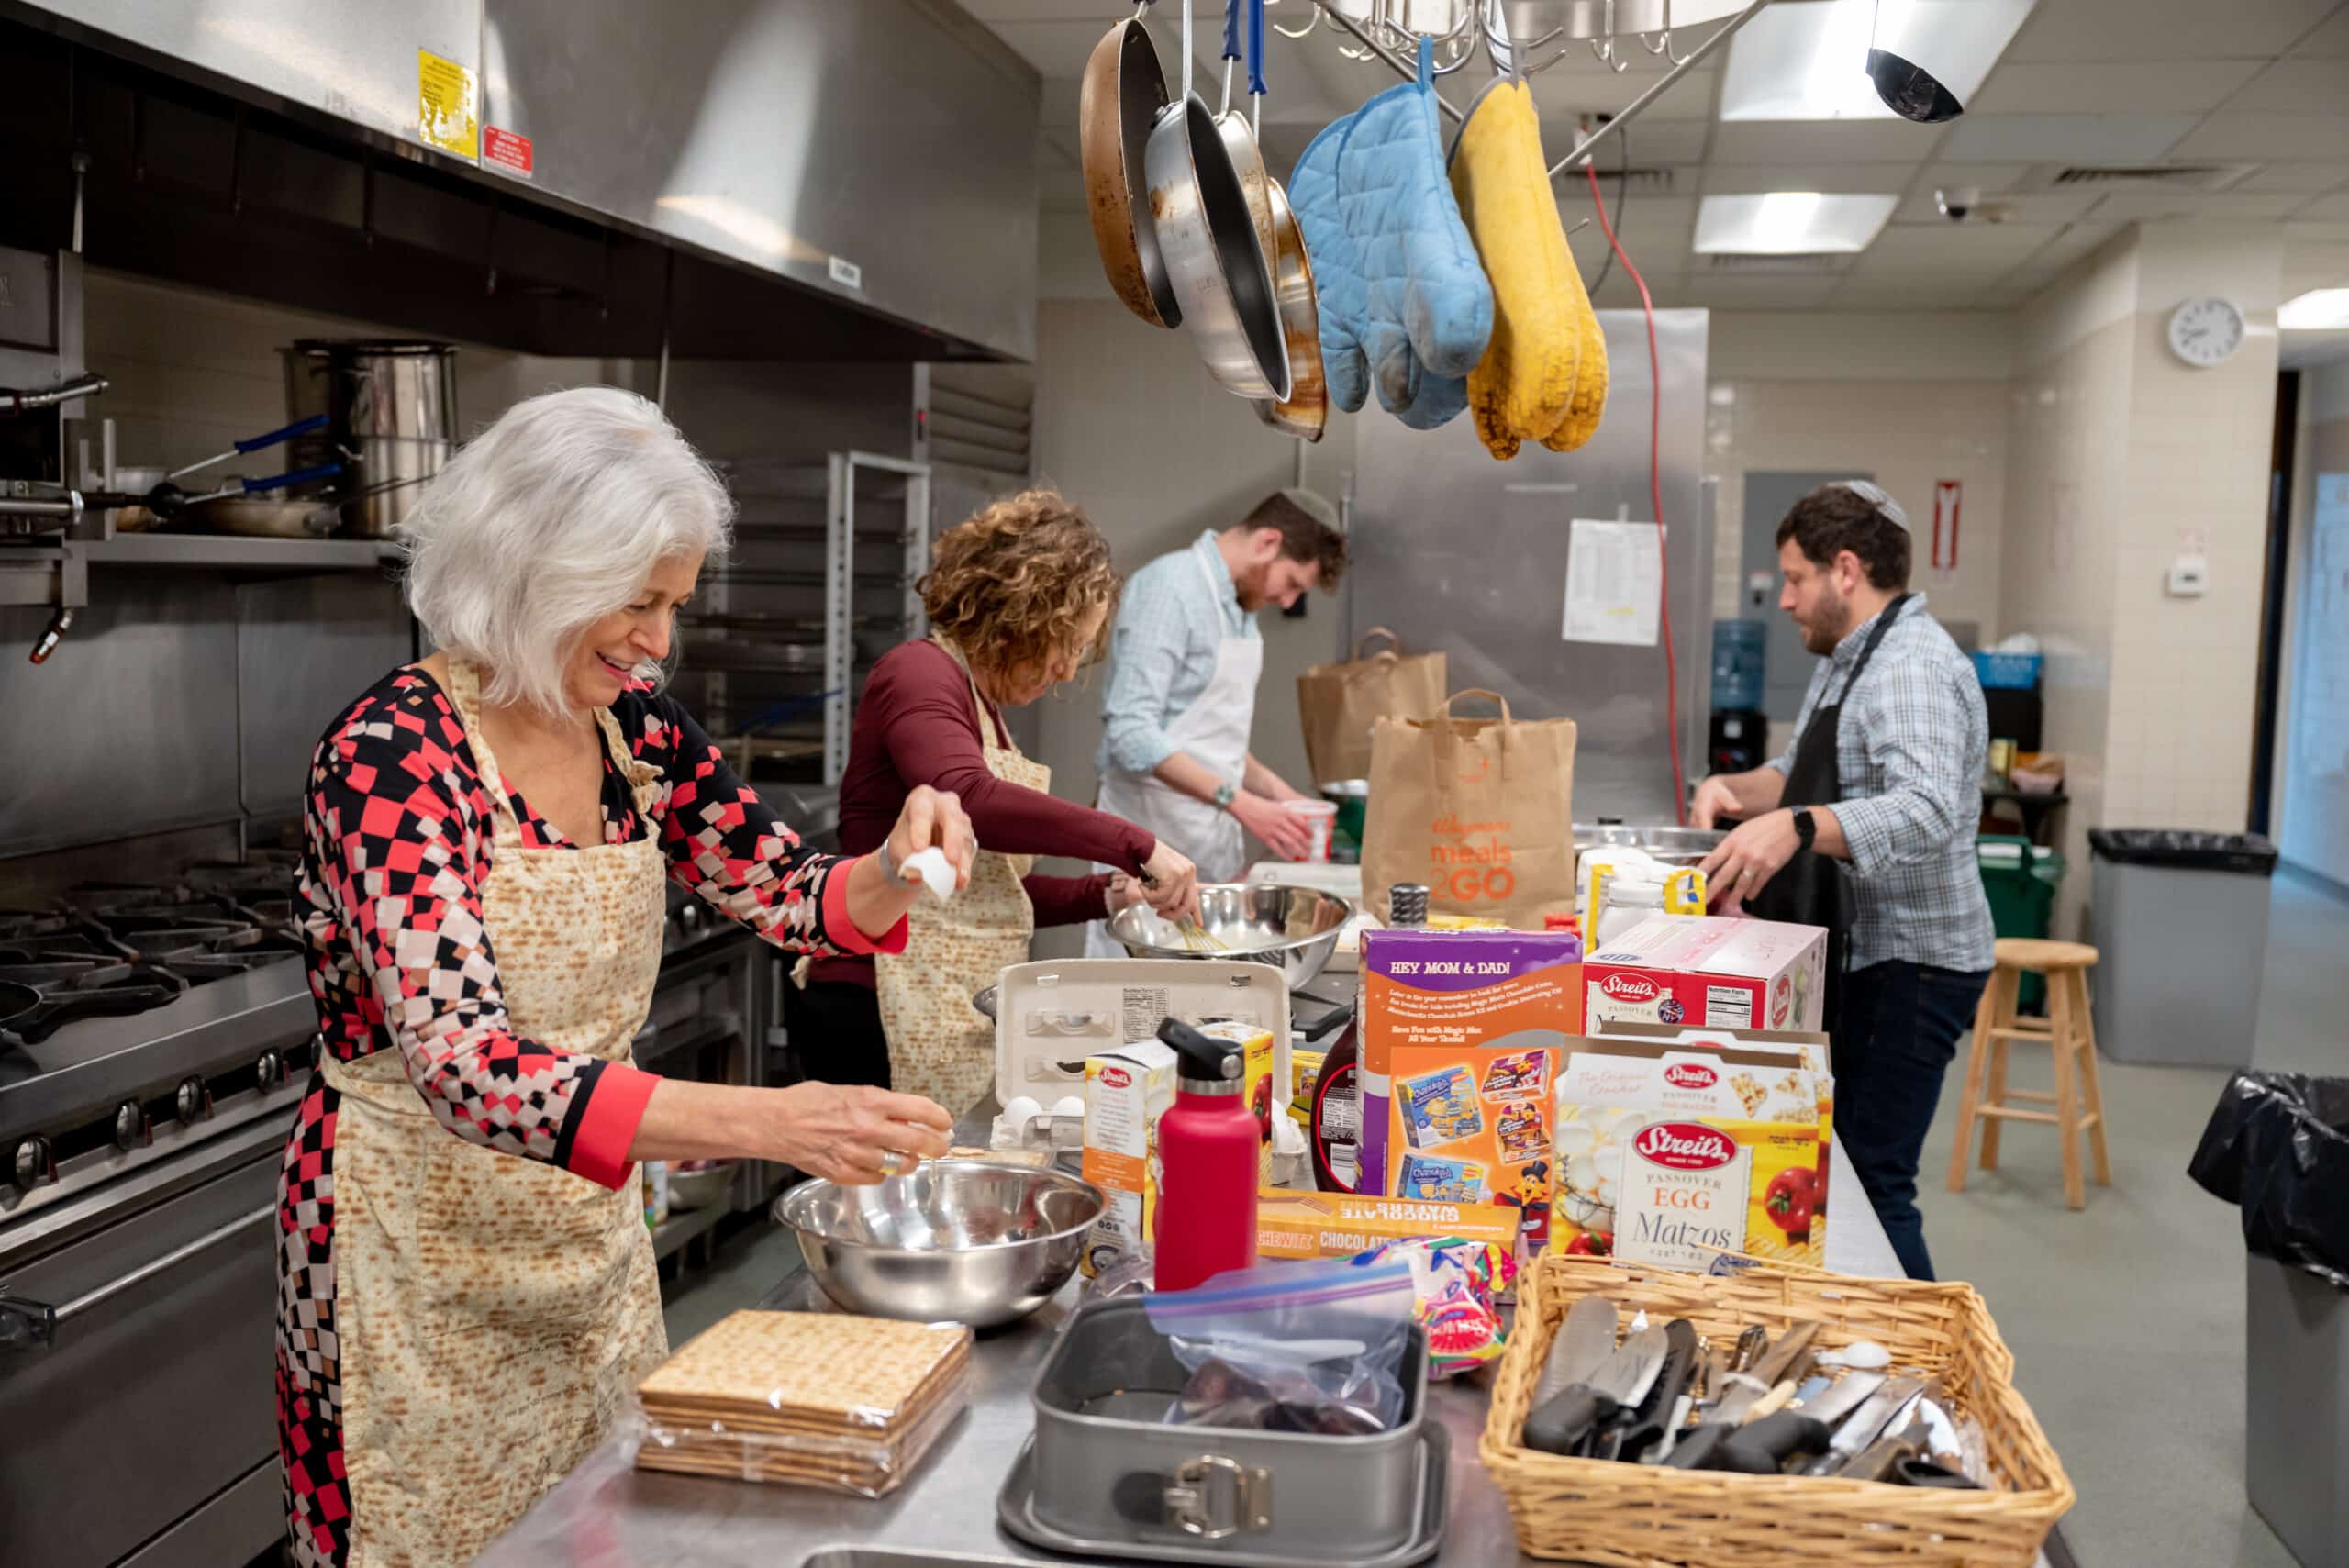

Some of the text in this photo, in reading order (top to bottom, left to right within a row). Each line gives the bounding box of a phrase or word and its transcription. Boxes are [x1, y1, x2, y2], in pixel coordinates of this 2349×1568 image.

[1431, 837, 1513, 864] meals
[1430, 867, 1514, 902] 2GO
[1390, 962, 1511, 974] HEY MOM & DAD!
[1603, 975, 1656, 997] Streit's
[1638, 1126, 1730, 1162] Streit's
[1646, 1173, 1722, 1190] PASSOVER
[1653, 1187, 1711, 1211] EGG
[1631, 1210, 1732, 1249] Matzos
